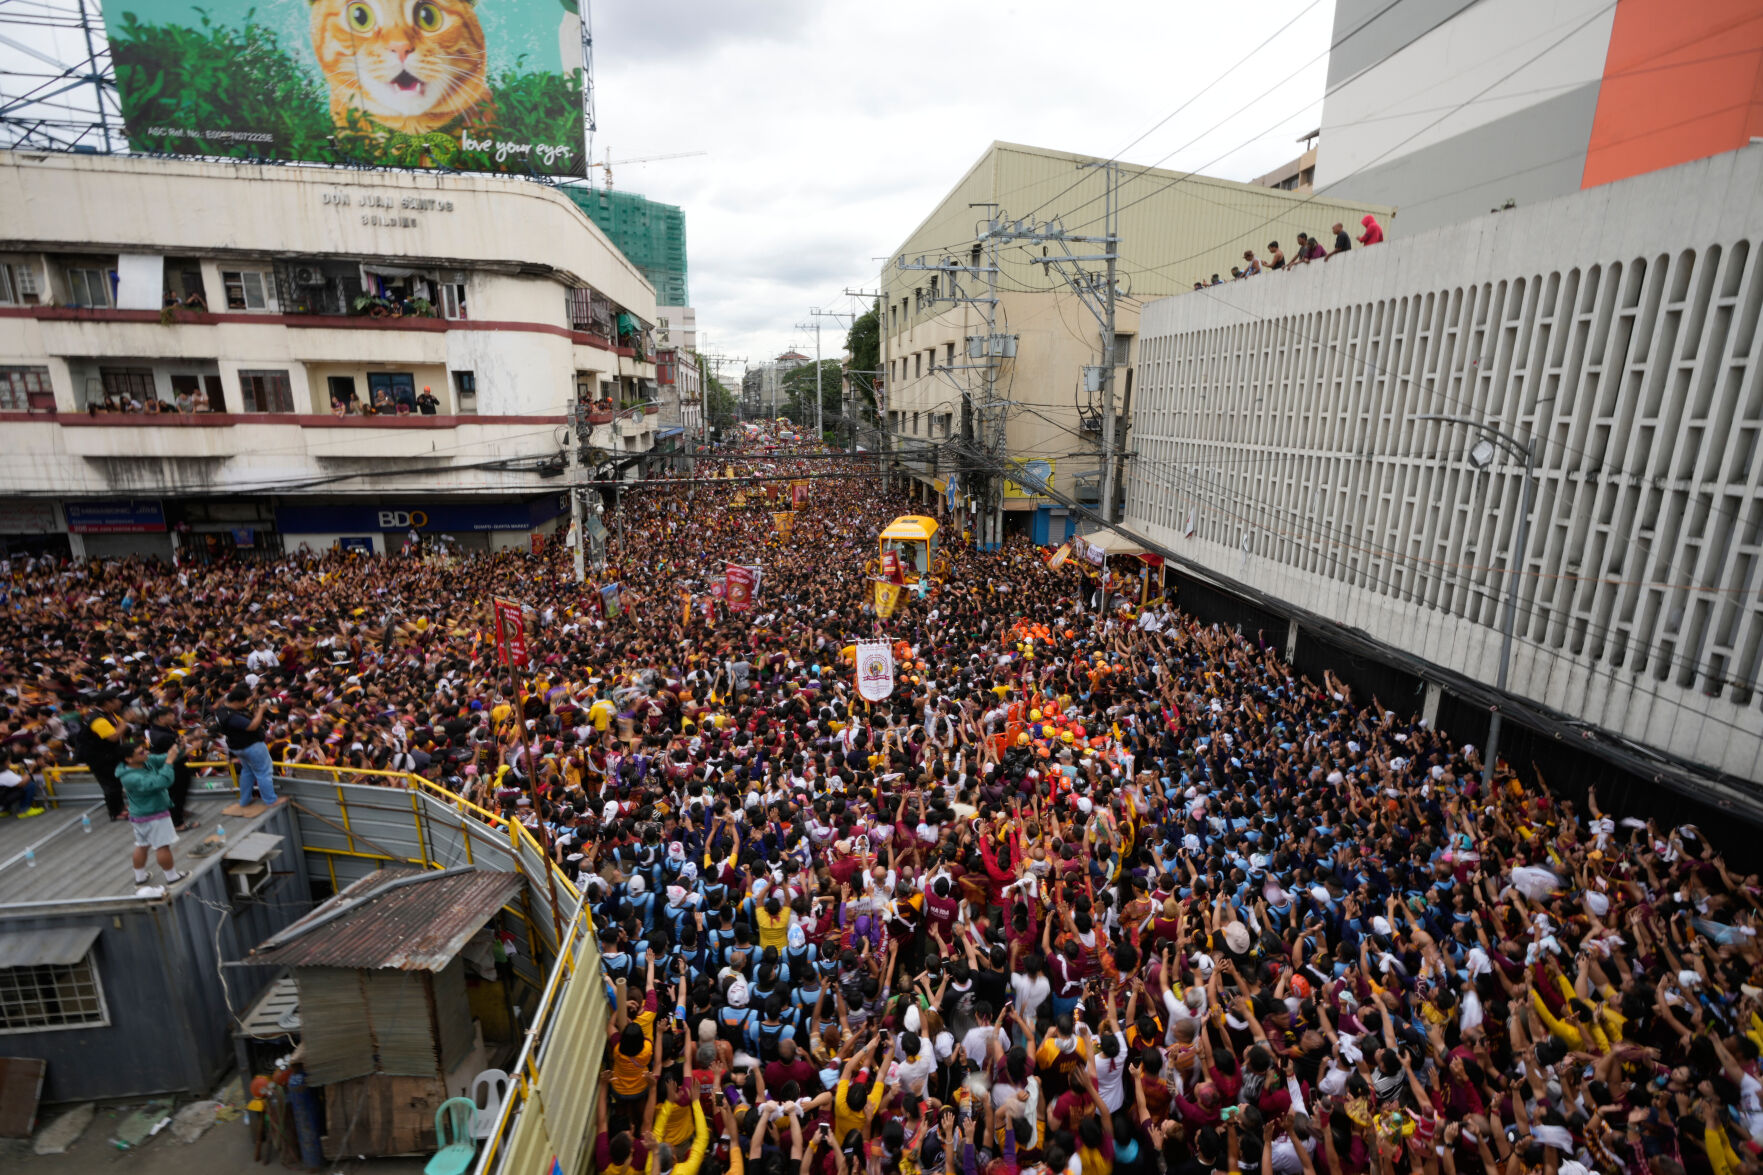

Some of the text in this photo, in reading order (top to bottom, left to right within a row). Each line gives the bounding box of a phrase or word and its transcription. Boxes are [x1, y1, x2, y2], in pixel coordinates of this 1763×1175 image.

[462, 129, 574, 166] love your eyes.
[322, 193, 455, 212] DON JUAN SANTOS
[360, 215, 418, 228] BUILDING
[378, 510, 428, 527] BDO
